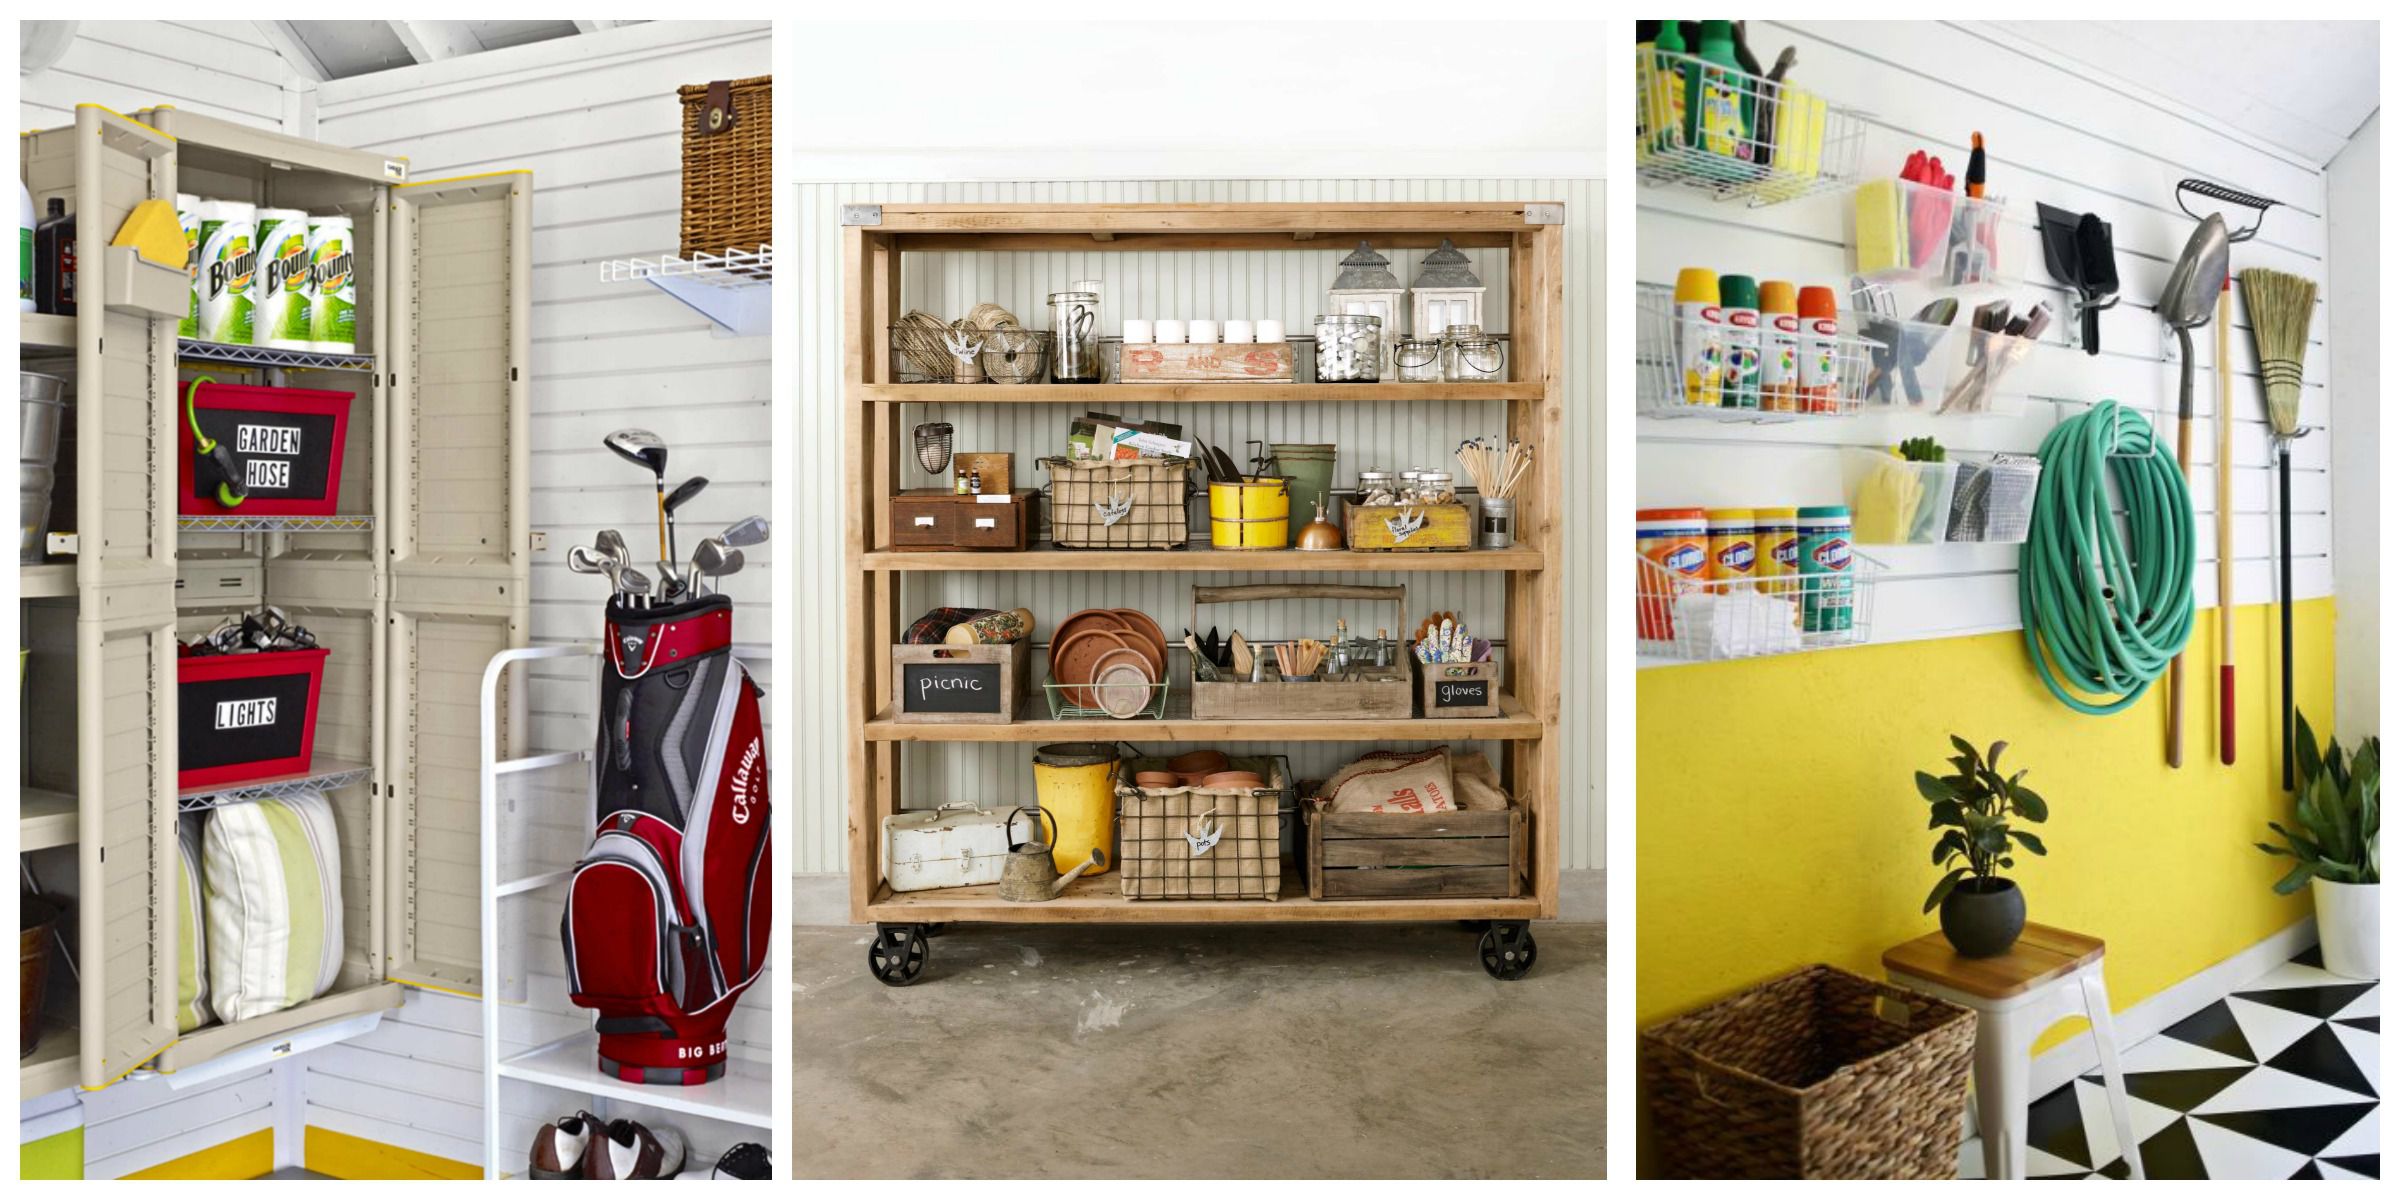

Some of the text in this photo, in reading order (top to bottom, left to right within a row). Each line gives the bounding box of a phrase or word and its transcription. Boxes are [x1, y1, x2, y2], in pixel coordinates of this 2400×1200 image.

[266, 248, 310, 299] Bount
[1243, 351, 1279, 375] S
[239, 426, 299, 453] GARDEN
[247, 461, 288, 486] HOSE
[920, 675, 983, 701] picnic
[1441, 684, 1482, 702] gloves
[218, 700, 275, 728] LIGHTS
[731, 736, 760, 825] Callaway
[1196, 839, 1211, 851] pots
[678, 1046, 703, 1059] BIG
